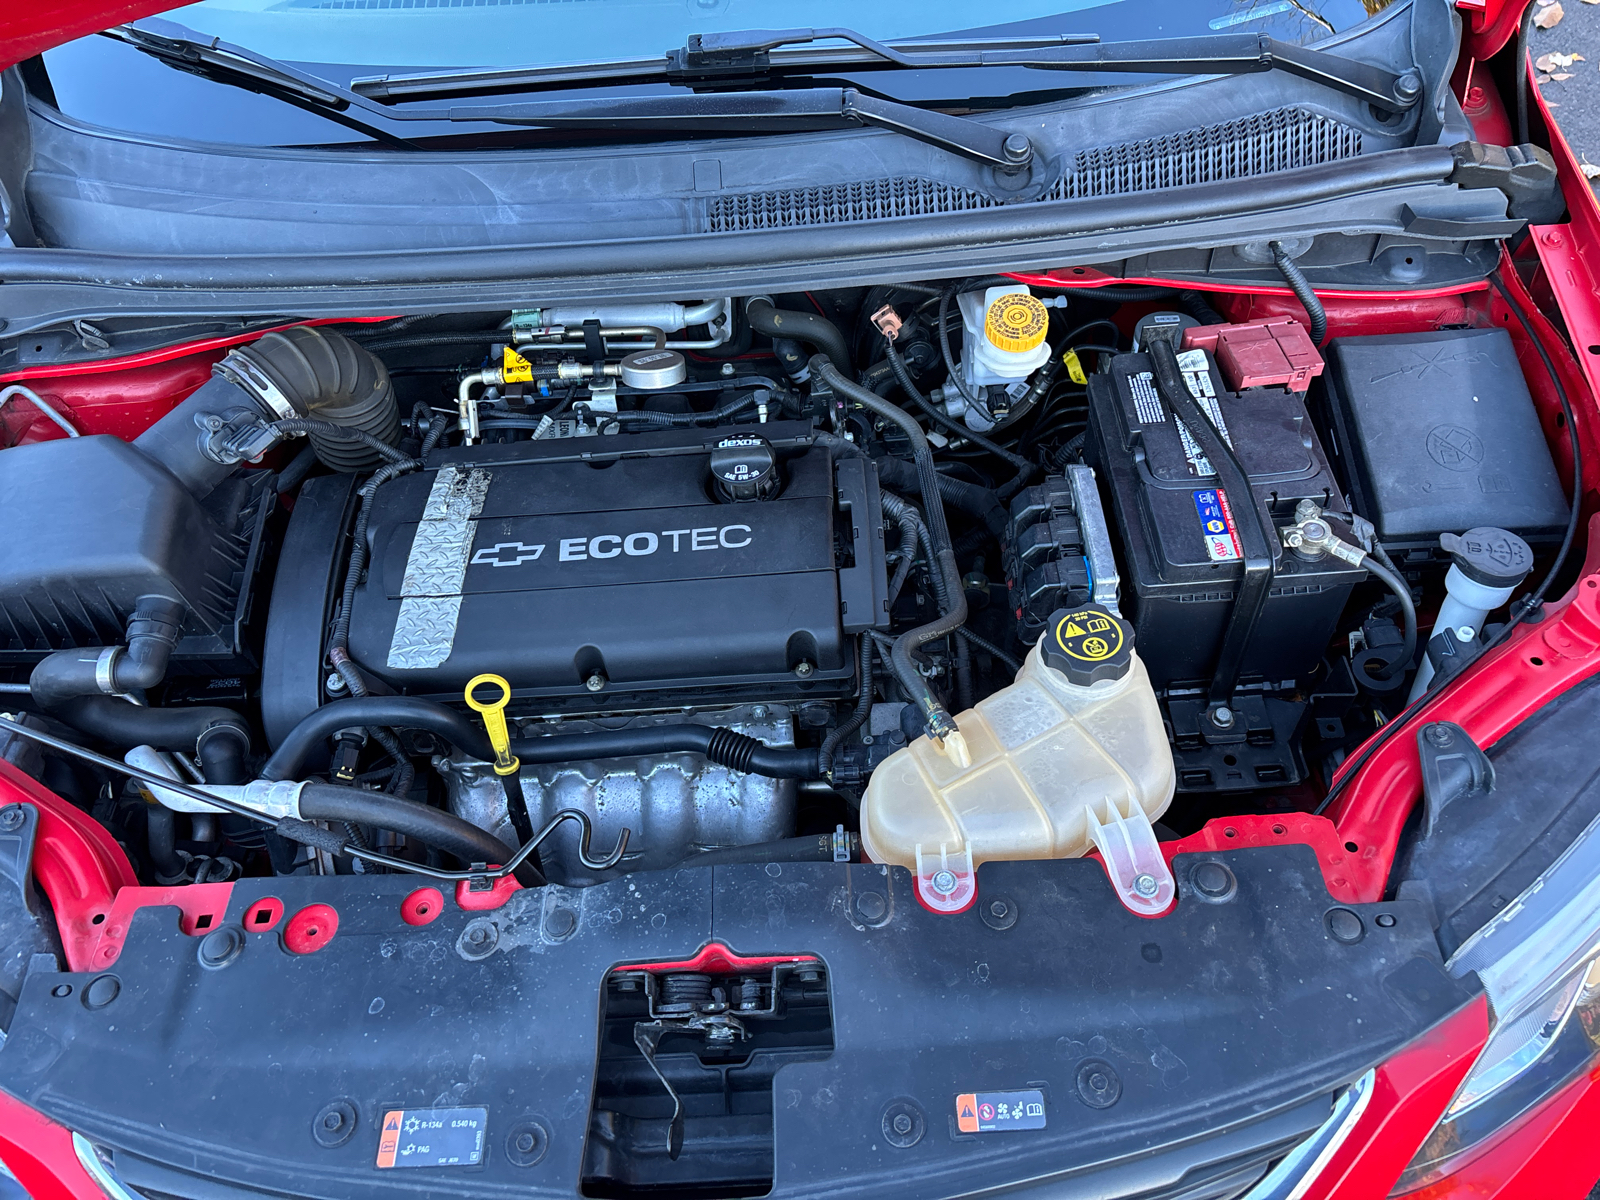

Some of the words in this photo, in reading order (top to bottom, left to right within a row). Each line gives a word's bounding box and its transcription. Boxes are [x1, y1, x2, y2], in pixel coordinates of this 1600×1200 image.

[719, 439, 762, 448] dexos
[1179, 433, 1192, 458] DANGER
[724, 472, 736, 480] SAE
[558, 524, 752, 562] ECOTEC
[469, 1120, 477, 1129] kg
[417, 1145, 430, 1153] PAG
